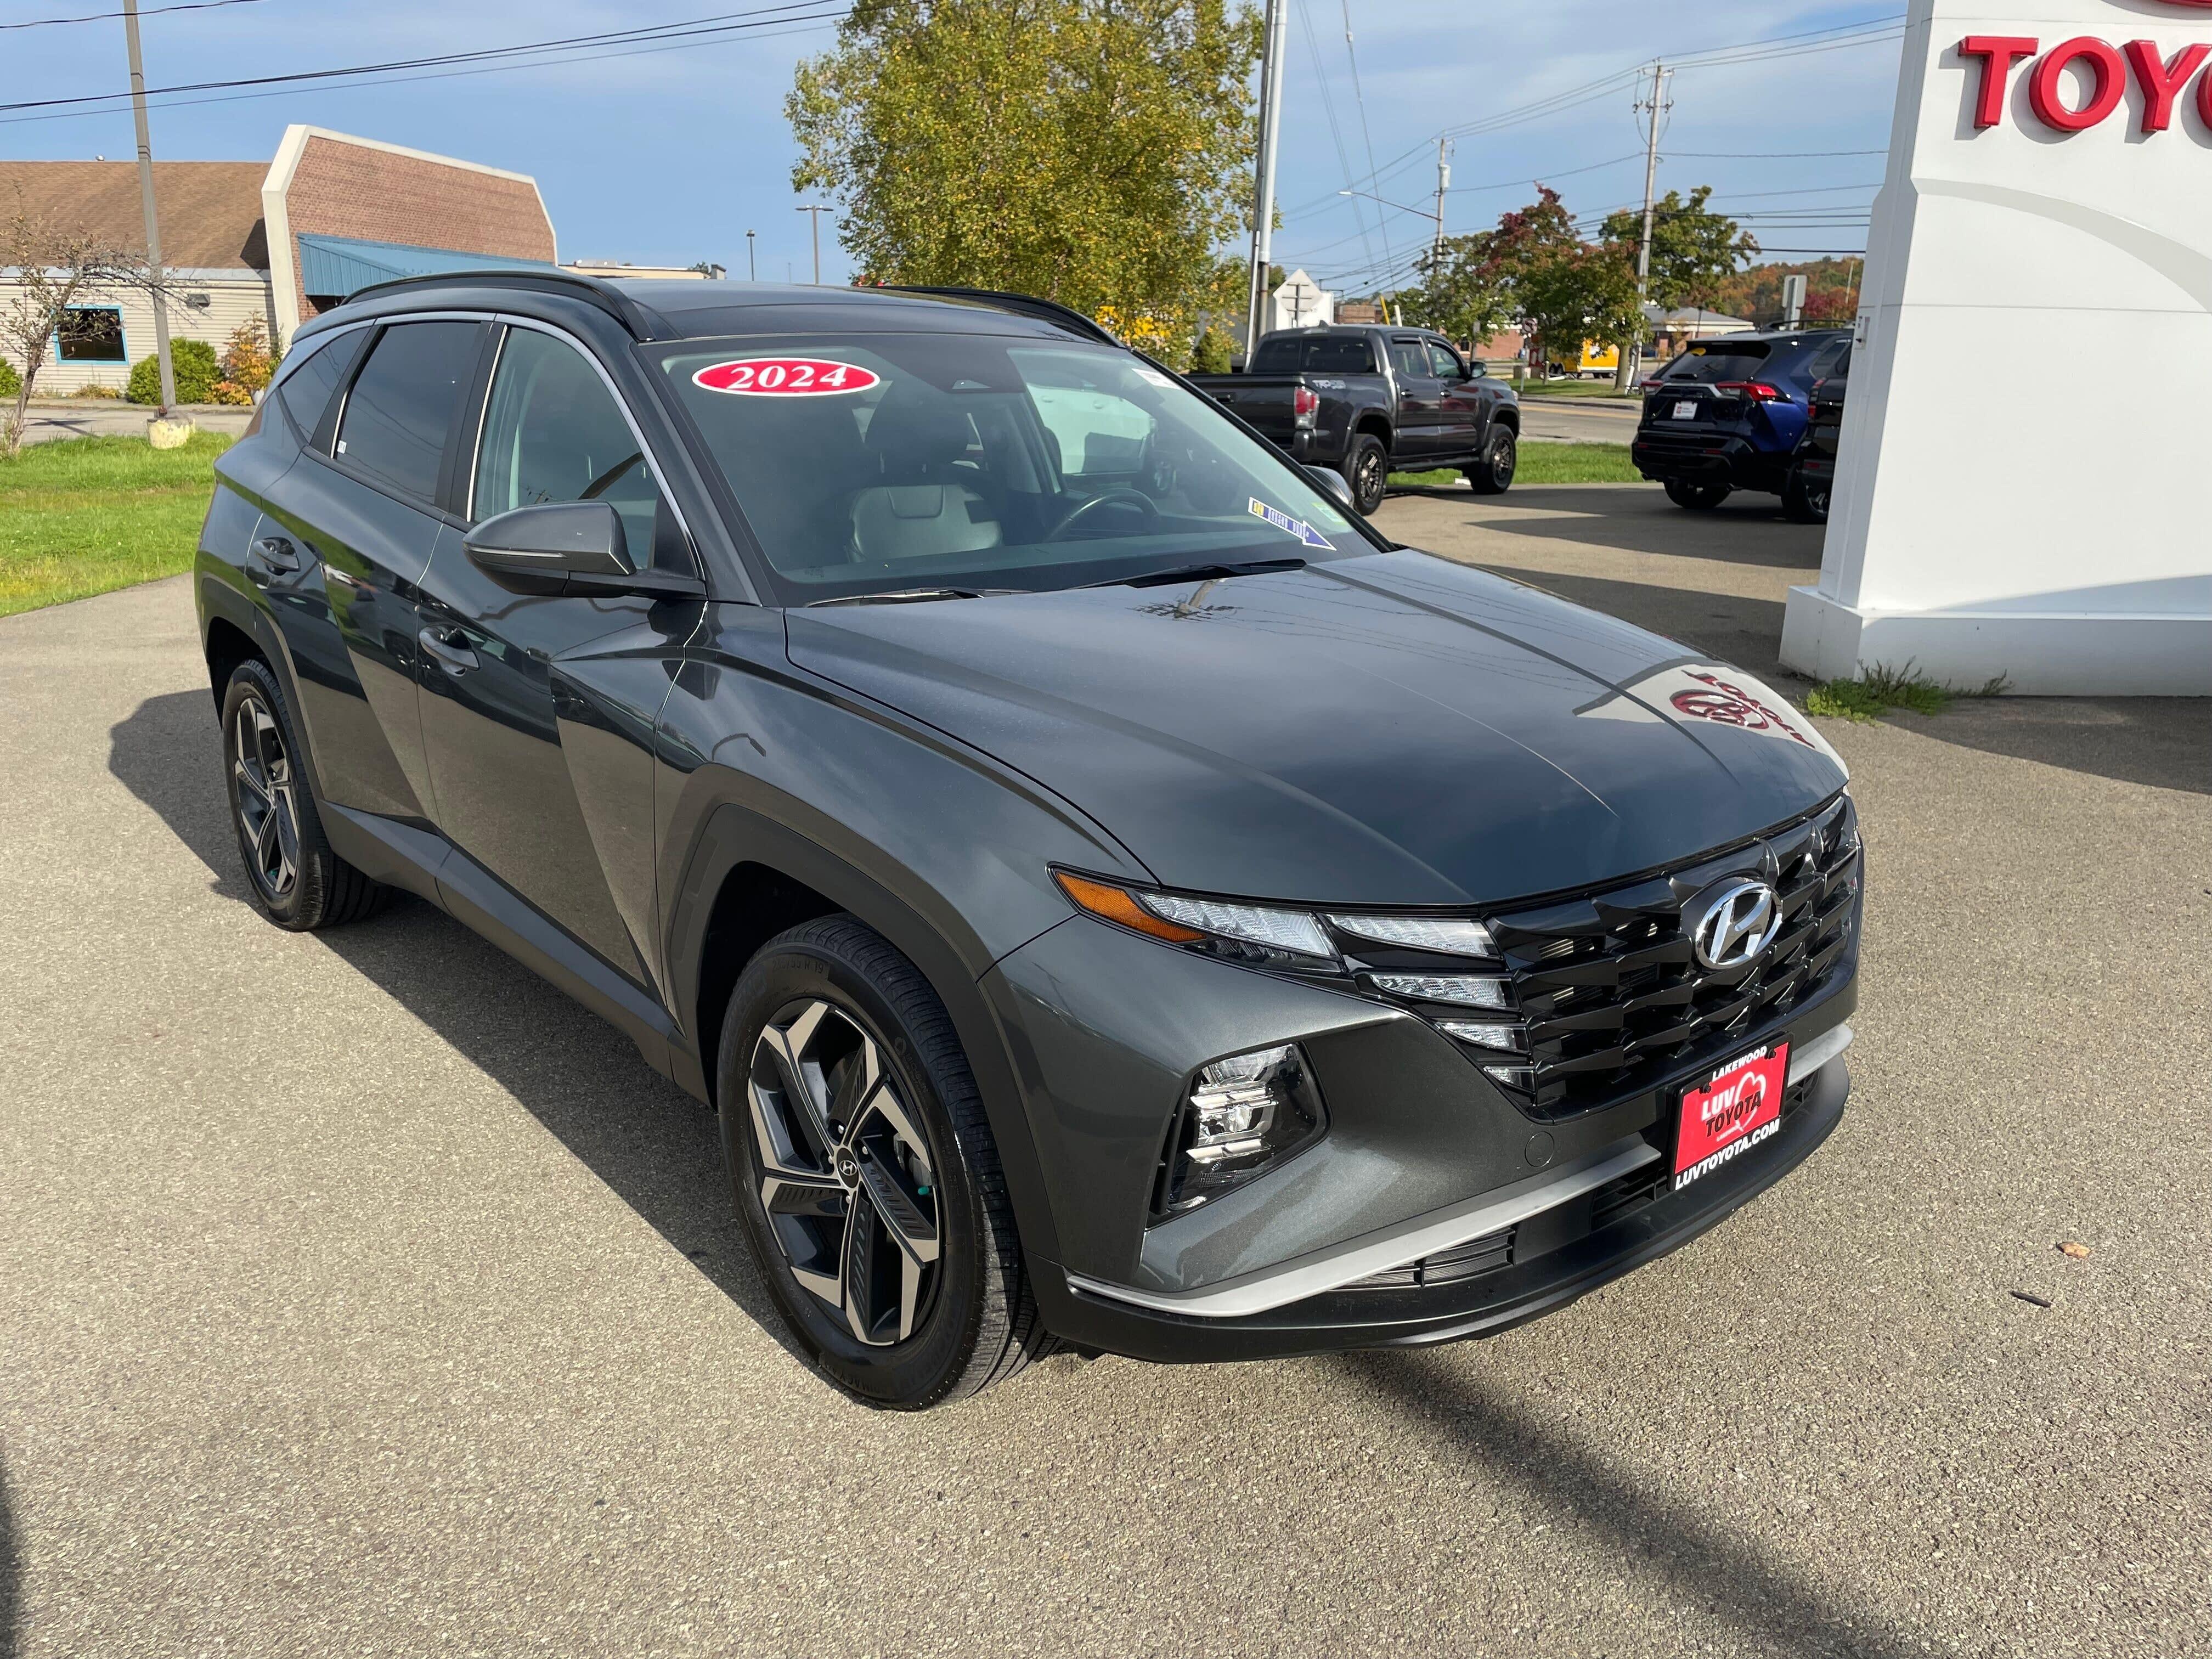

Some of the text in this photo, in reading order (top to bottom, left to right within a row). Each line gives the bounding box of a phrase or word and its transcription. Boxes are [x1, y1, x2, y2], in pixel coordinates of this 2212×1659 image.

[1958, 36, 2212, 132] TOY
[727, 365, 847, 389] 2024
[1712, 1045, 1767, 1082] LAKEWOOD
[1701, 1085, 1736, 1121] LUV
[1705, 1091, 1762, 1137] TOYOTA
[1675, 1119, 1780, 1190] LUVTOYOTA.COM
